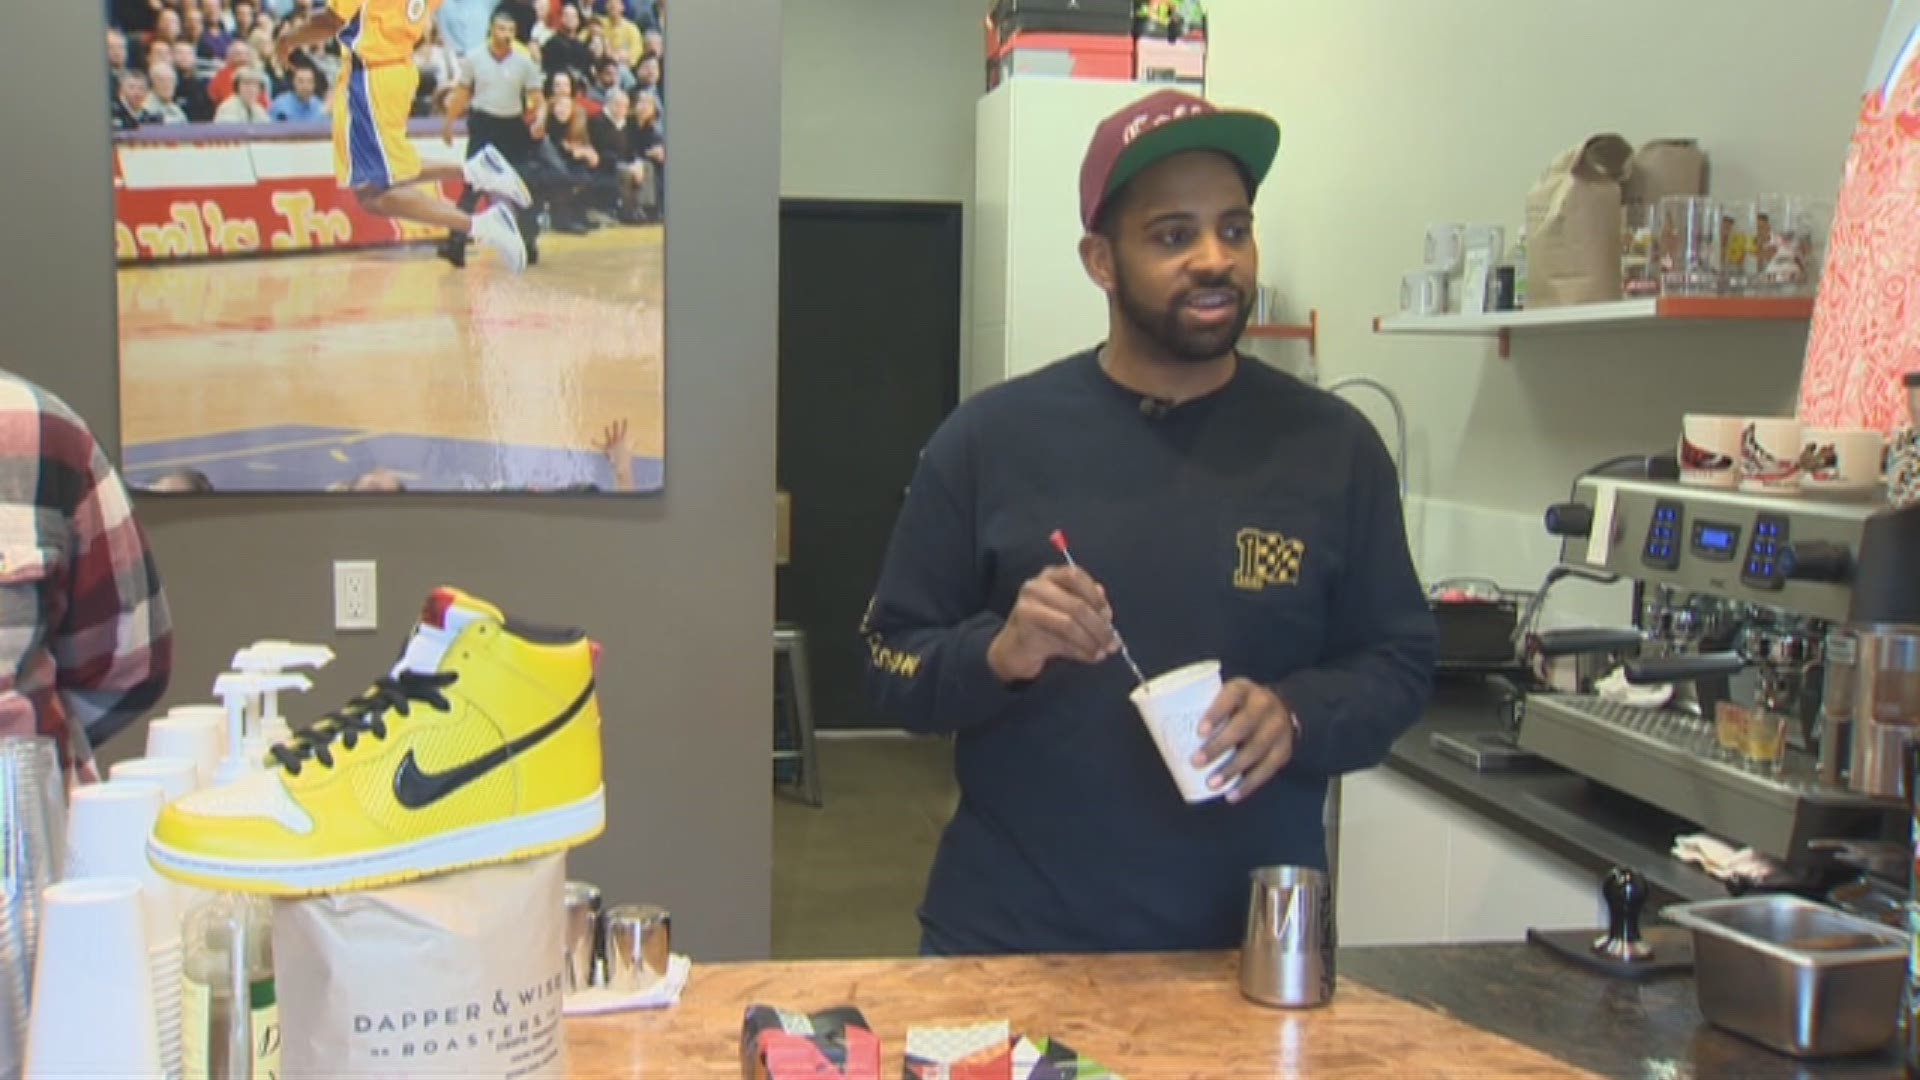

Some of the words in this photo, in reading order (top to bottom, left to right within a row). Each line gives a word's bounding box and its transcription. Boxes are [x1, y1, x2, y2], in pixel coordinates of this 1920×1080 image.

[354, 1003, 480, 1033] DAPPER
[493, 989, 509, 1016] &
[519, 973, 562, 1006] WISE
[402, 1013, 542, 1057] ROASTERS
